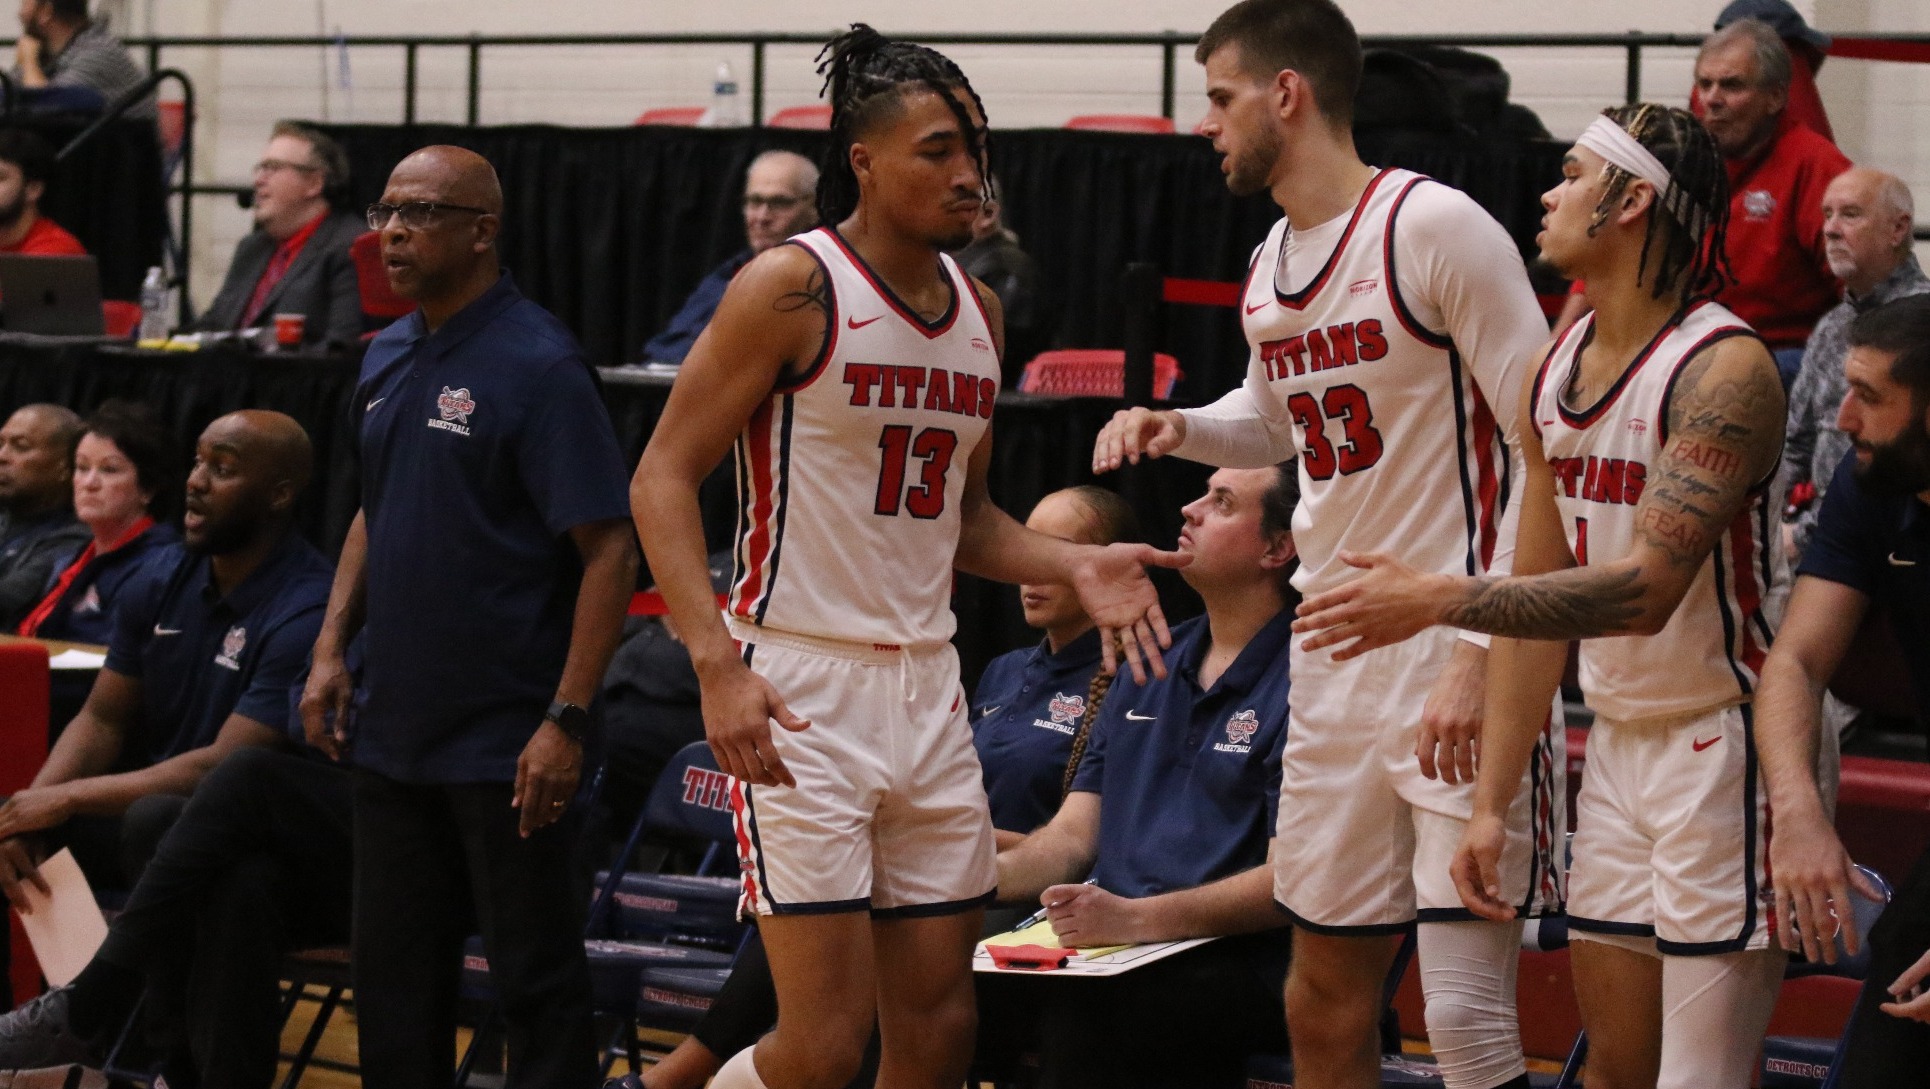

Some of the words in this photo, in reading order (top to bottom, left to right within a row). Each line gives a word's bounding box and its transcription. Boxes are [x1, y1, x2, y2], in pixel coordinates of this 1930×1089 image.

[1259, 318, 1389, 382] TITANS
[843, 362, 996, 420] TITANS
[427, 419, 471, 436] BASKETBALL
[1287, 383, 1384, 481] 33
[874, 424, 958, 520] 13
[1671, 440, 1741, 476] FAITH
[1644, 506, 1704, 550] FEAR
[1033, 718, 1075, 735] BASKETBALL
[1813, 1065, 1829, 1079] CO
